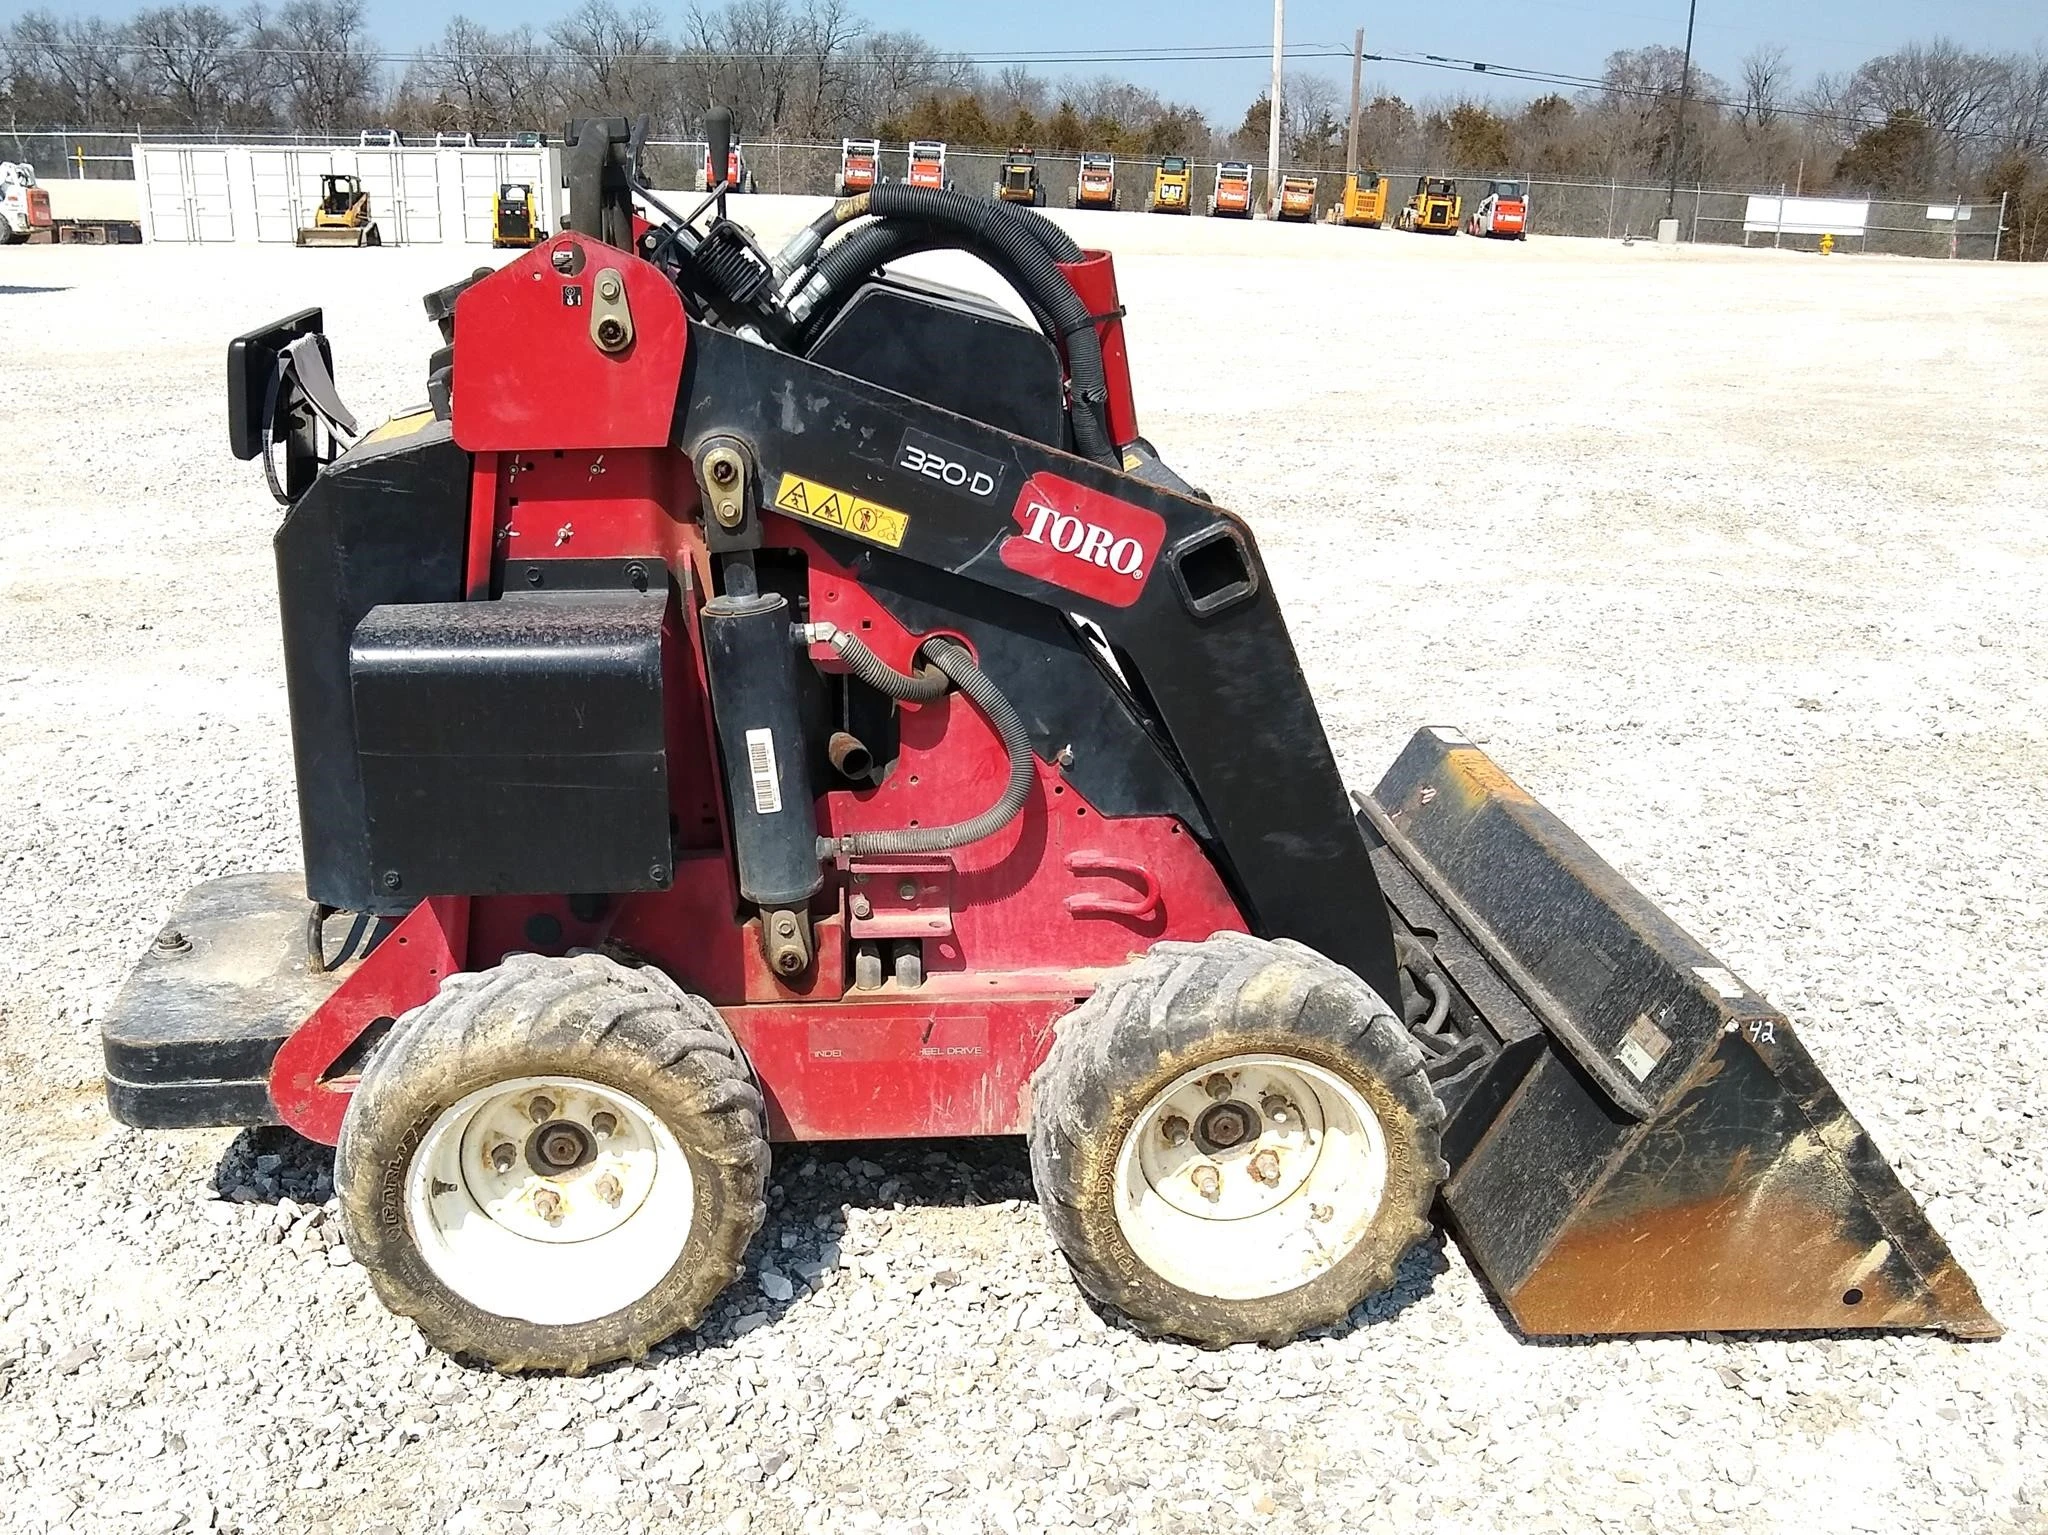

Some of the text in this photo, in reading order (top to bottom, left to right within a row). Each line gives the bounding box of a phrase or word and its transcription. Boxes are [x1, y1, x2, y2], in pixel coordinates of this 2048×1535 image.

[1161, 184, 1181, 200] CAT
[1024, 501, 1144, 576] TORO
[1750, 1020, 1776, 1045] 42
[947, 1046, 982, 1056] DRIVE
